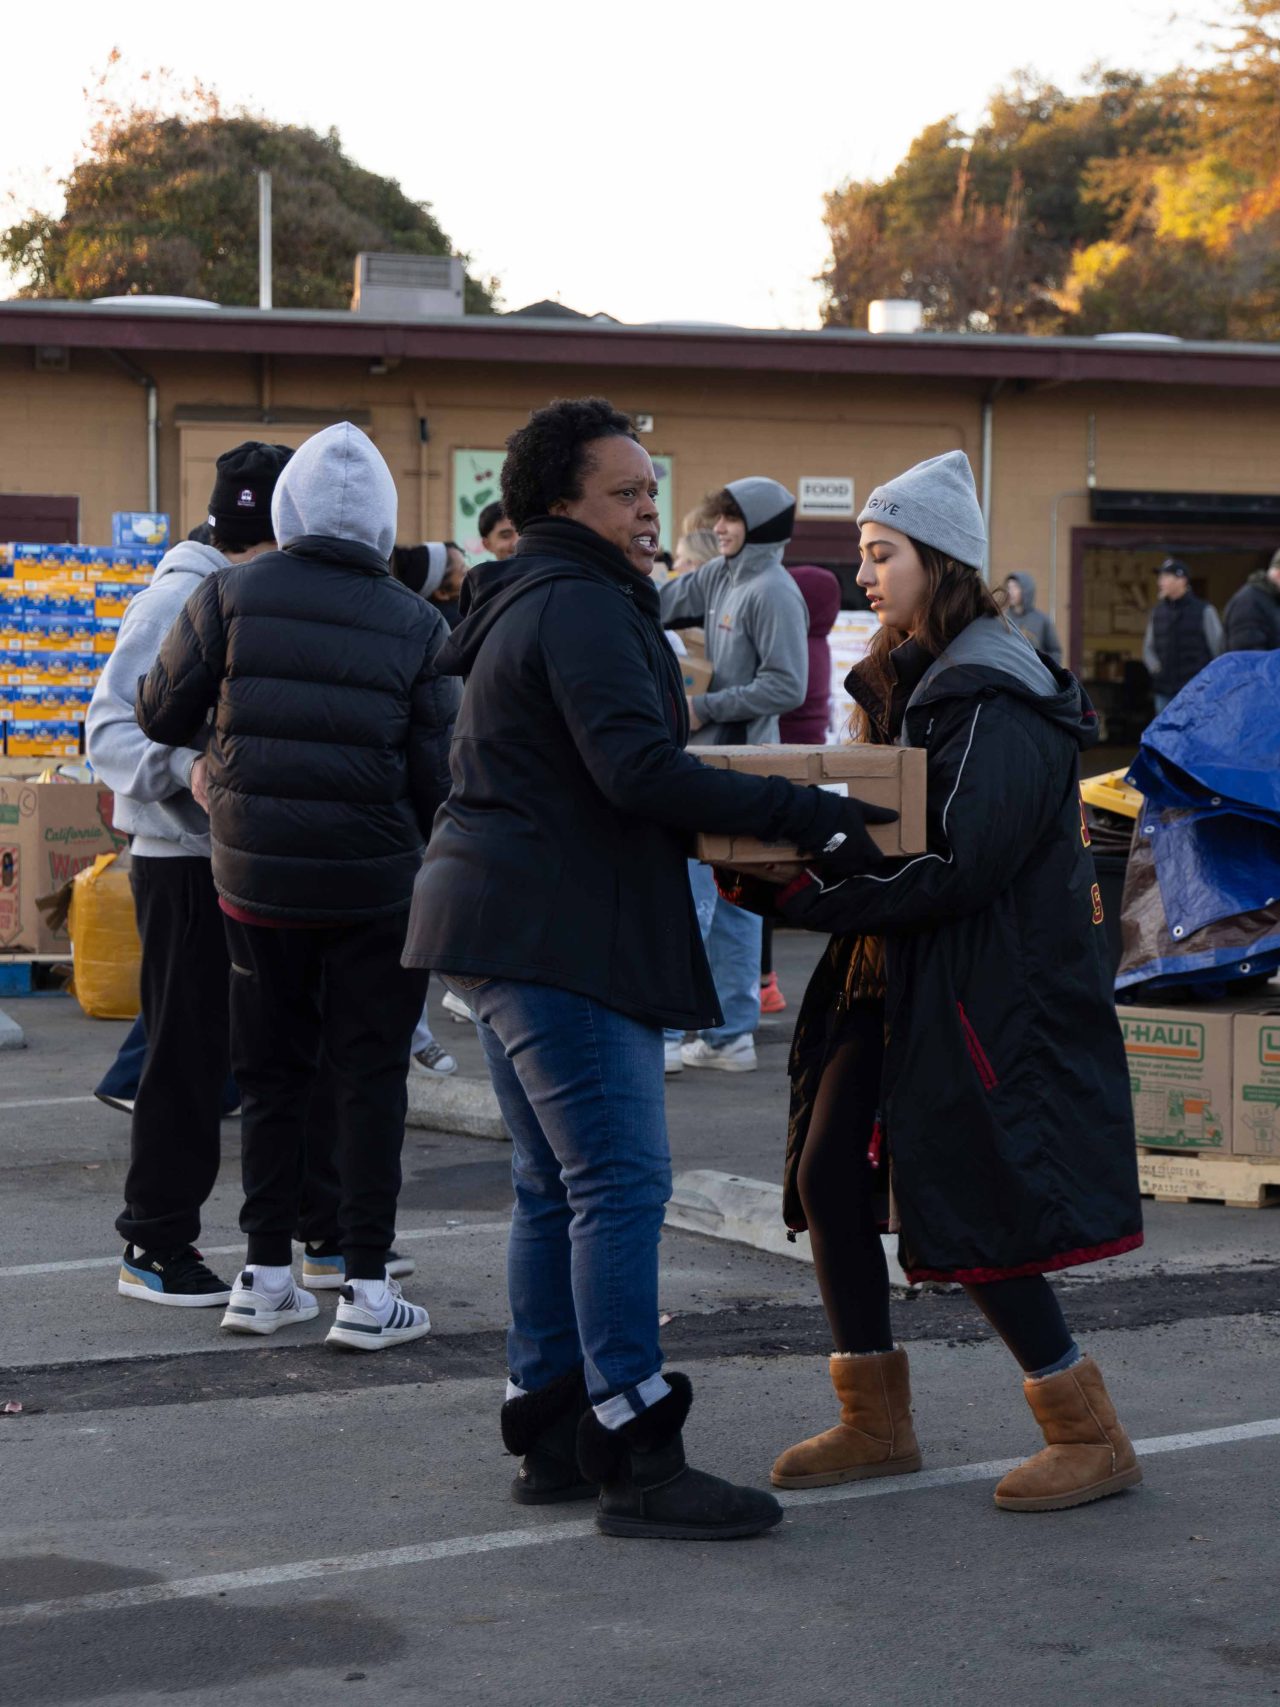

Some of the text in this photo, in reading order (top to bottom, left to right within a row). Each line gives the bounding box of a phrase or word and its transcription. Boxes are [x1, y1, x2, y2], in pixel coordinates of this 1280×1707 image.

[804, 482, 849, 497] FOOD
[868, 498, 900, 516] GIVE
[45, 826, 103, 845] California
